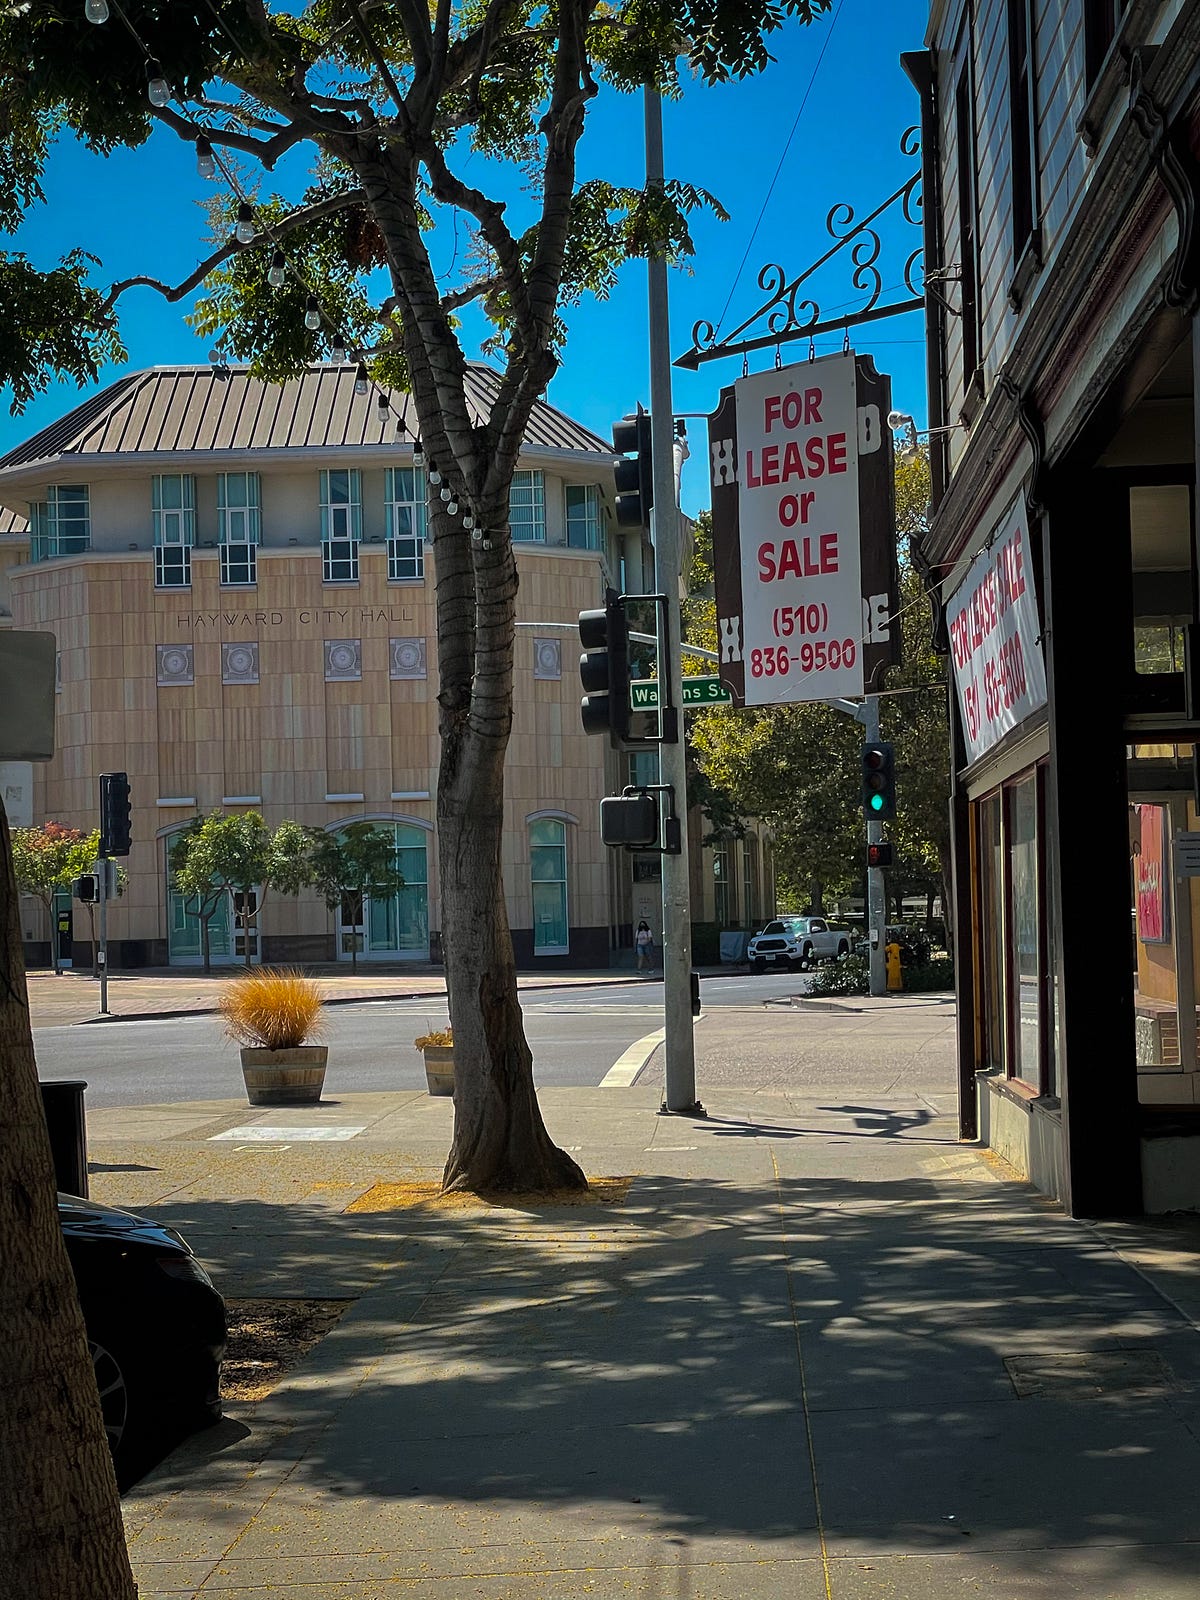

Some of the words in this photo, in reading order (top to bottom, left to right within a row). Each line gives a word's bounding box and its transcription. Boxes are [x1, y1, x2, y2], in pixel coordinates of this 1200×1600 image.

[764, 387, 823, 433] FOR
[746, 433, 847, 488] LEASE
[778, 492, 815, 528] or
[757, 533, 838, 584] SALE
[177, 612, 283, 628] HAYWARD
[299, 610, 348, 625] CITY
[361, 608, 413, 622] HALL
[950, 607, 972, 669] FOR
[970, 566, 997, 653] LEASE
[996, 527, 1026, 619] SALE
[772, 603, 828, 638] (510)
[751, 638, 856, 678] 836-9500
